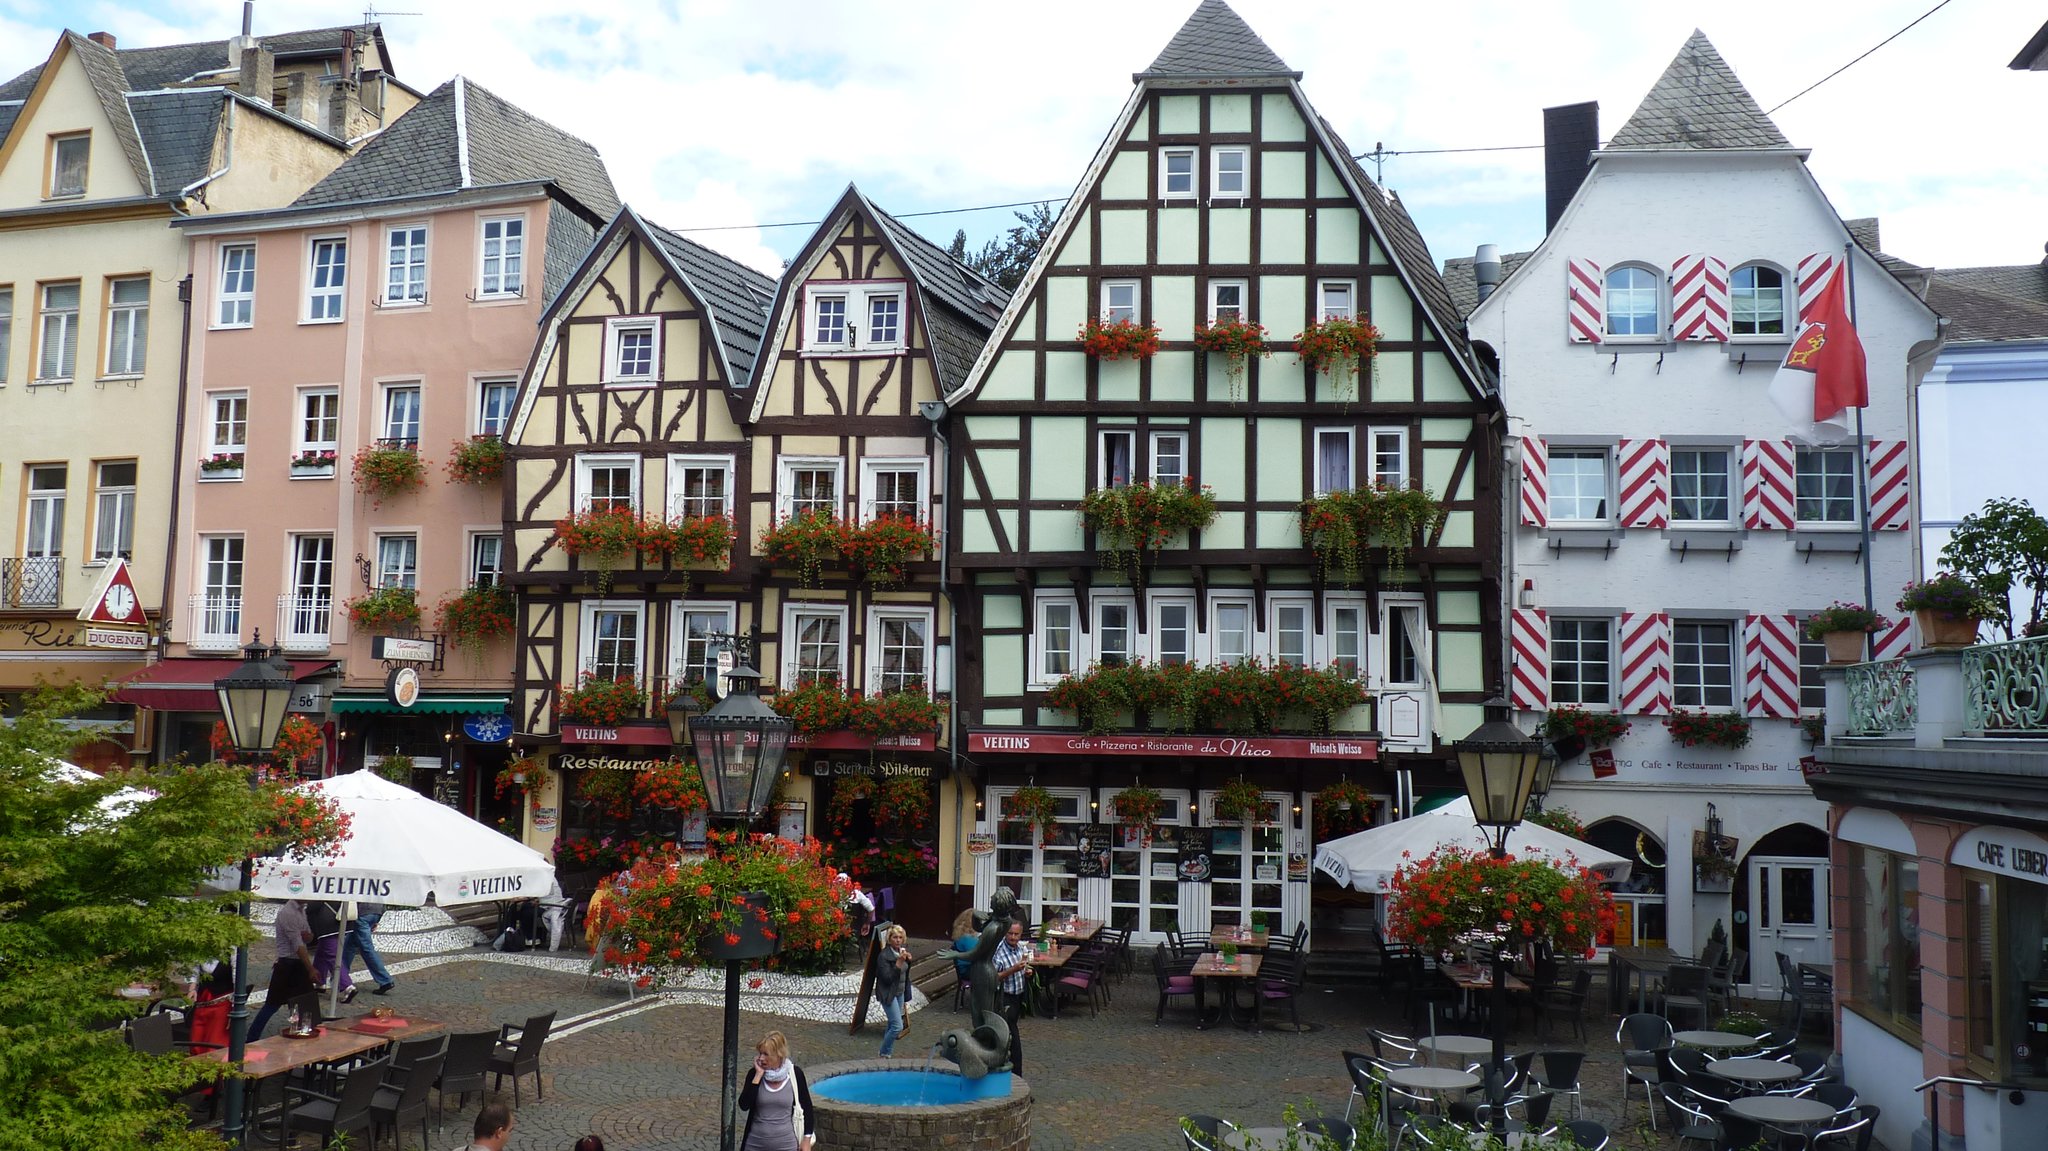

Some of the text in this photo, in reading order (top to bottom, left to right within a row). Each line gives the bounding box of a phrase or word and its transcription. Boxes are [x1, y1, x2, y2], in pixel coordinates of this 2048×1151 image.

[88, 633, 145, 646] DUGENA
[576, 728, 618, 741] VELTINS
[983, 736, 1030, 749] VELTINS
[1067, 737, 1272, 757] Café Pizzeria Ristorante da Nico
[1338, 742, 1362, 755] Weisse
[880, 760, 933, 778] Pilsener
[1676, 761, 1723, 770] Restaurant
[1734, 762, 1760, 773] Tapas
[1762, 763, 1778, 771] Bar
[312, 876, 391, 897] VELTINS
[472, 875, 523, 895] VELTINS
